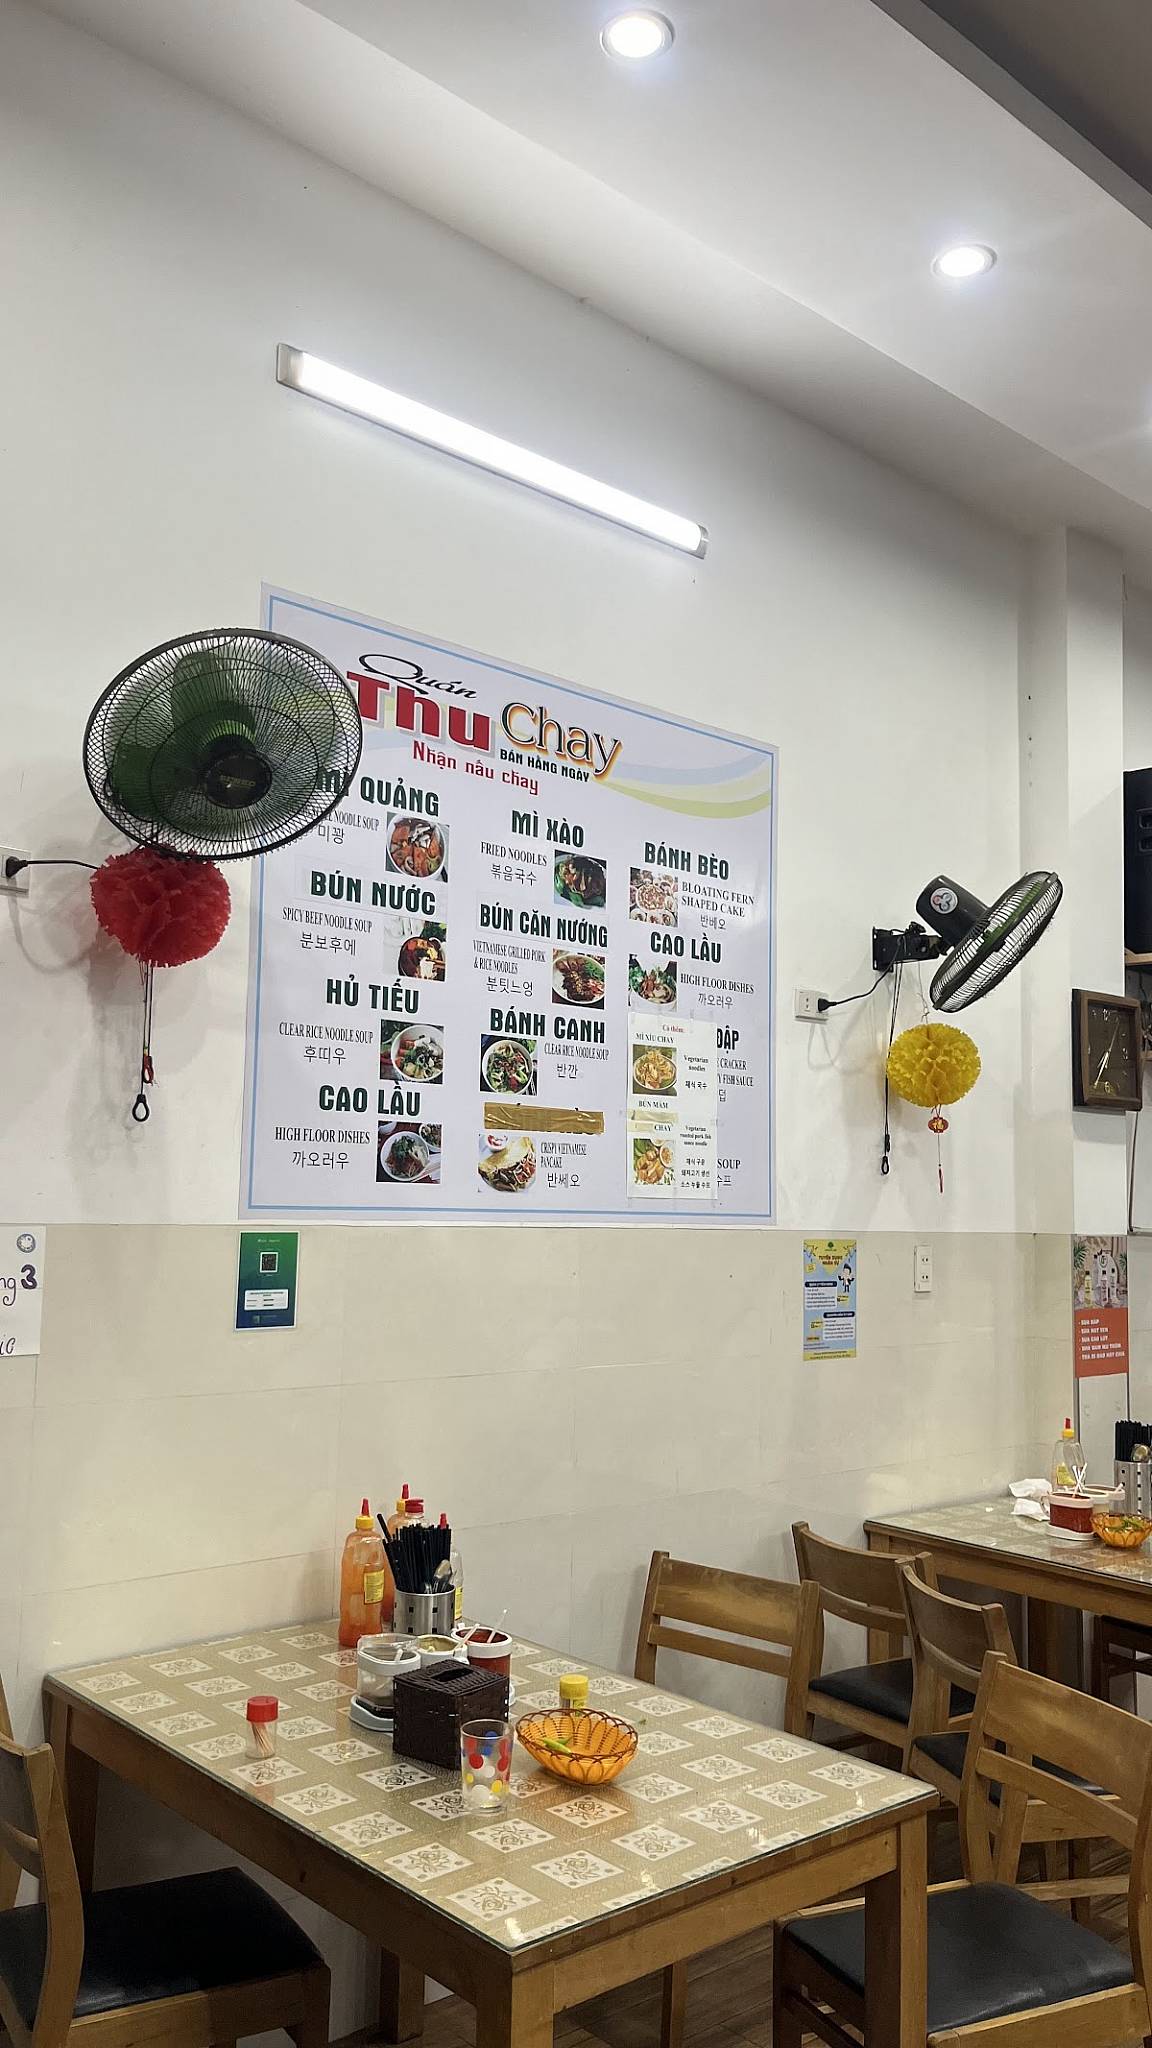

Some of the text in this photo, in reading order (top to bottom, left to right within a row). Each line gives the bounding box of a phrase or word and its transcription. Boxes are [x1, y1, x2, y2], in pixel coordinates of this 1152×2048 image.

[359, 653, 477, 699] Quán
[347, 671, 621, 777] Thu Chay
[413, 740, 457, 771] Nhận
[502, 770, 539, 796] chay
[500, 749, 523, 765] BÁN
[561, 766, 590, 783] NGÀY
[360, 778, 439, 817] QUẢNG
[362, 816, 380, 831] SOUP
[511, 810, 584, 848] MÌ XÀO
[481, 841, 547, 867] FRIED NOODLES
[645, 842, 729, 880] BÁNH BÈO
[491, 864, 537, 886] 볶음국수
[310, 870, 436, 916] BÚN NƯỚC
[682, 881, 755, 906] BLOATING FERN
[681, 896, 745, 918] SHAPED CAKE
[283, 907, 373, 933] SPICY BEEF NOODLE SOUP
[480, 901, 608, 948] BÚN CĂN NƯỚNG
[300, 931, 356, 956] 분보후에
[473, 940, 547, 962] VIETNAMESE GRILLED PORK
[650, 931, 721, 963] CAO LẦU
[474, 957, 518, 974] & RICE NOODLES
[326, 974, 420, 1014] HỦ TIẾU
[680, 973, 755, 994] HIGH FLOOR DISHES
[698, 993, 734, 1009] 까오러우
[279, 1022, 374, 1044] CLEAR RICE NOODLE SOUP
[490, 1006, 605, 1044] BÁNH CANH
[657, 1035, 674, 1043] CHAY
[303, 1045, 347, 1065] 후띠우
[596, 1049, 609, 1060] SOUP
[720, 1057, 747, 1070] CRACKER
[557, 1064, 578, 1079] 반깐
[736, 1075, 753, 1087] SAUCE
[319, 1081, 421, 1116] CAO LẦU
[275, 1127, 370, 1145] HIGH FLOOR DISHES
[292, 1150, 350, 1170] 까오러우
[717, 1158, 741, 1170] SOUP
[20, 1263, 38, 1290] 3
